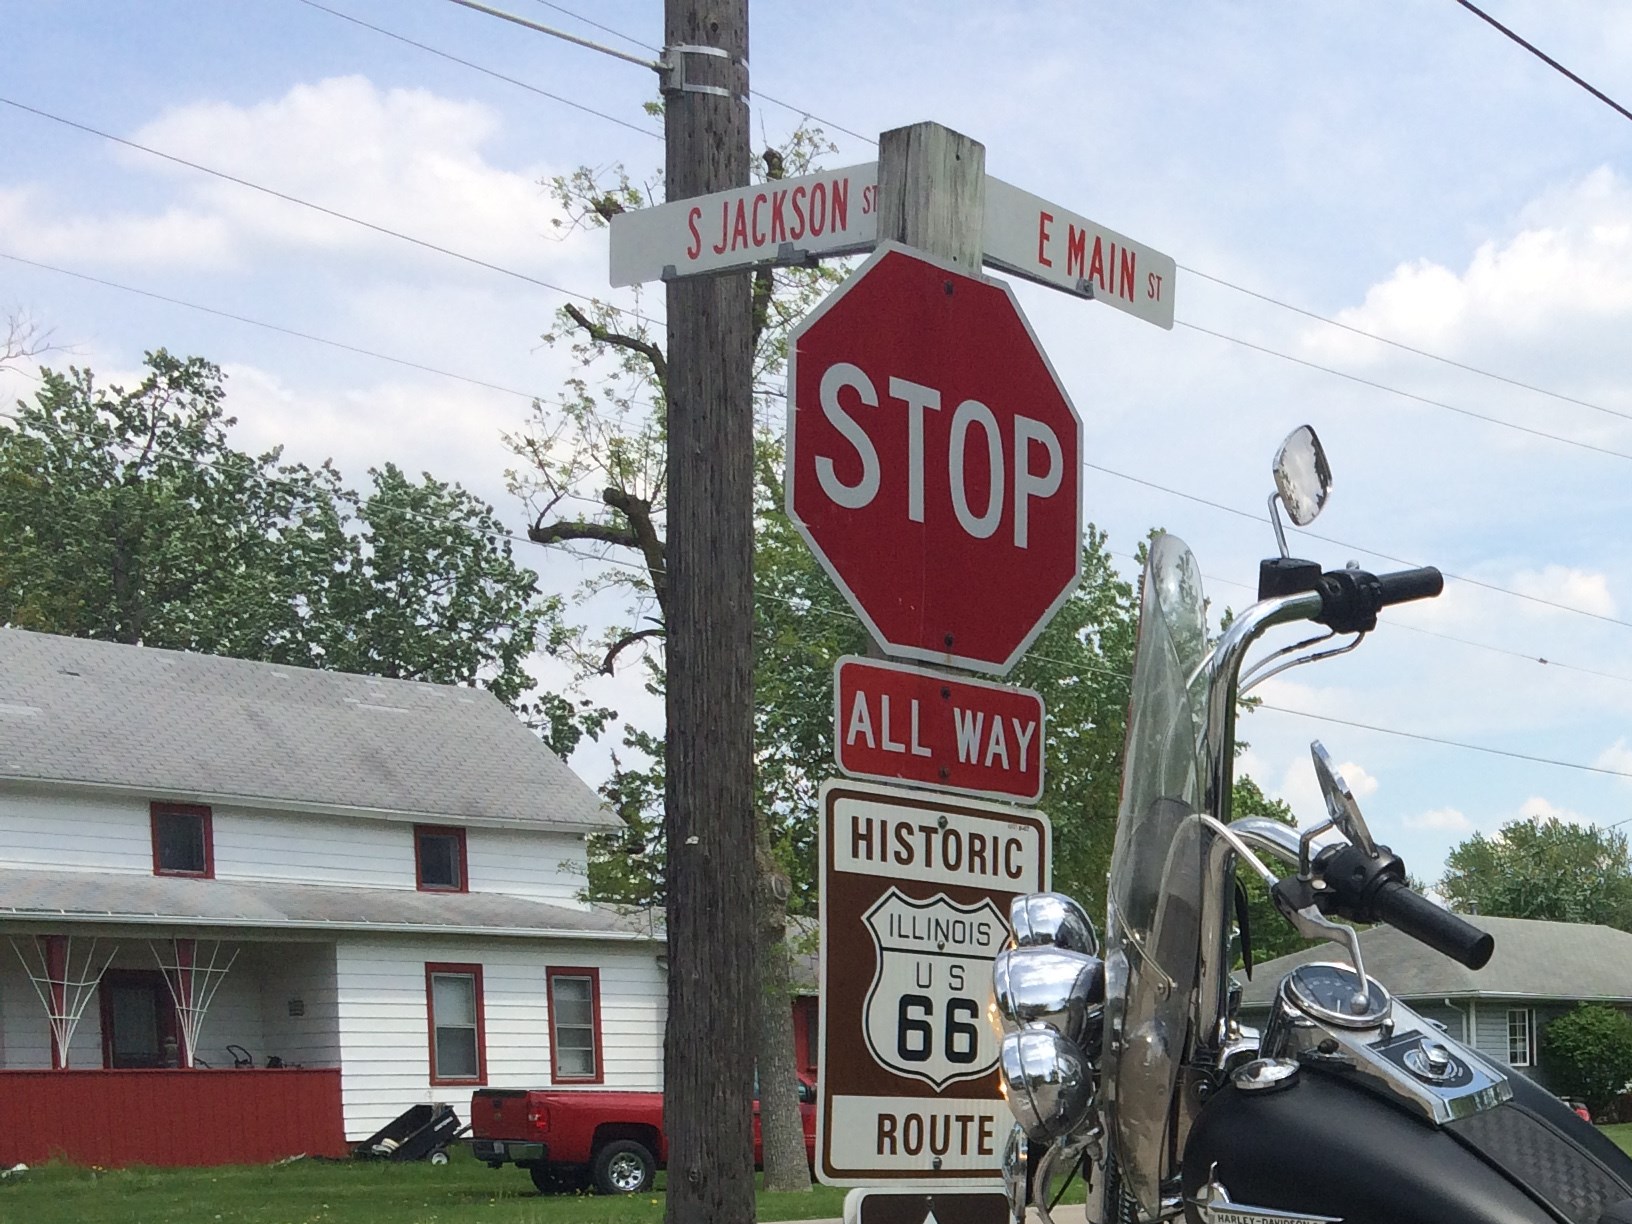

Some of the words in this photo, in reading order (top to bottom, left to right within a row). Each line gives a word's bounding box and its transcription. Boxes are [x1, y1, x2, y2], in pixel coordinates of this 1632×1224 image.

[687, 206, 702, 260] S
[713, 177, 850, 255] JACKSON
[863, 184, 879, 214] ST
[1039, 212, 1054, 268] E
[1067, 225, 1136, 303] MAIN
[1147, 271, 1163, 302] ST
[814, 362, 1064, 550] STOP
[847, 690, 932, 758] ALL
[953, 706, 1036, 773] WAY
[851, 815, 1023, 880] HISTORIC
[889, 912, 992, 947] ILLINOIS
[899, 993, 980, 1065] 66
[876, 1112, 995, 1157] ROUTE
